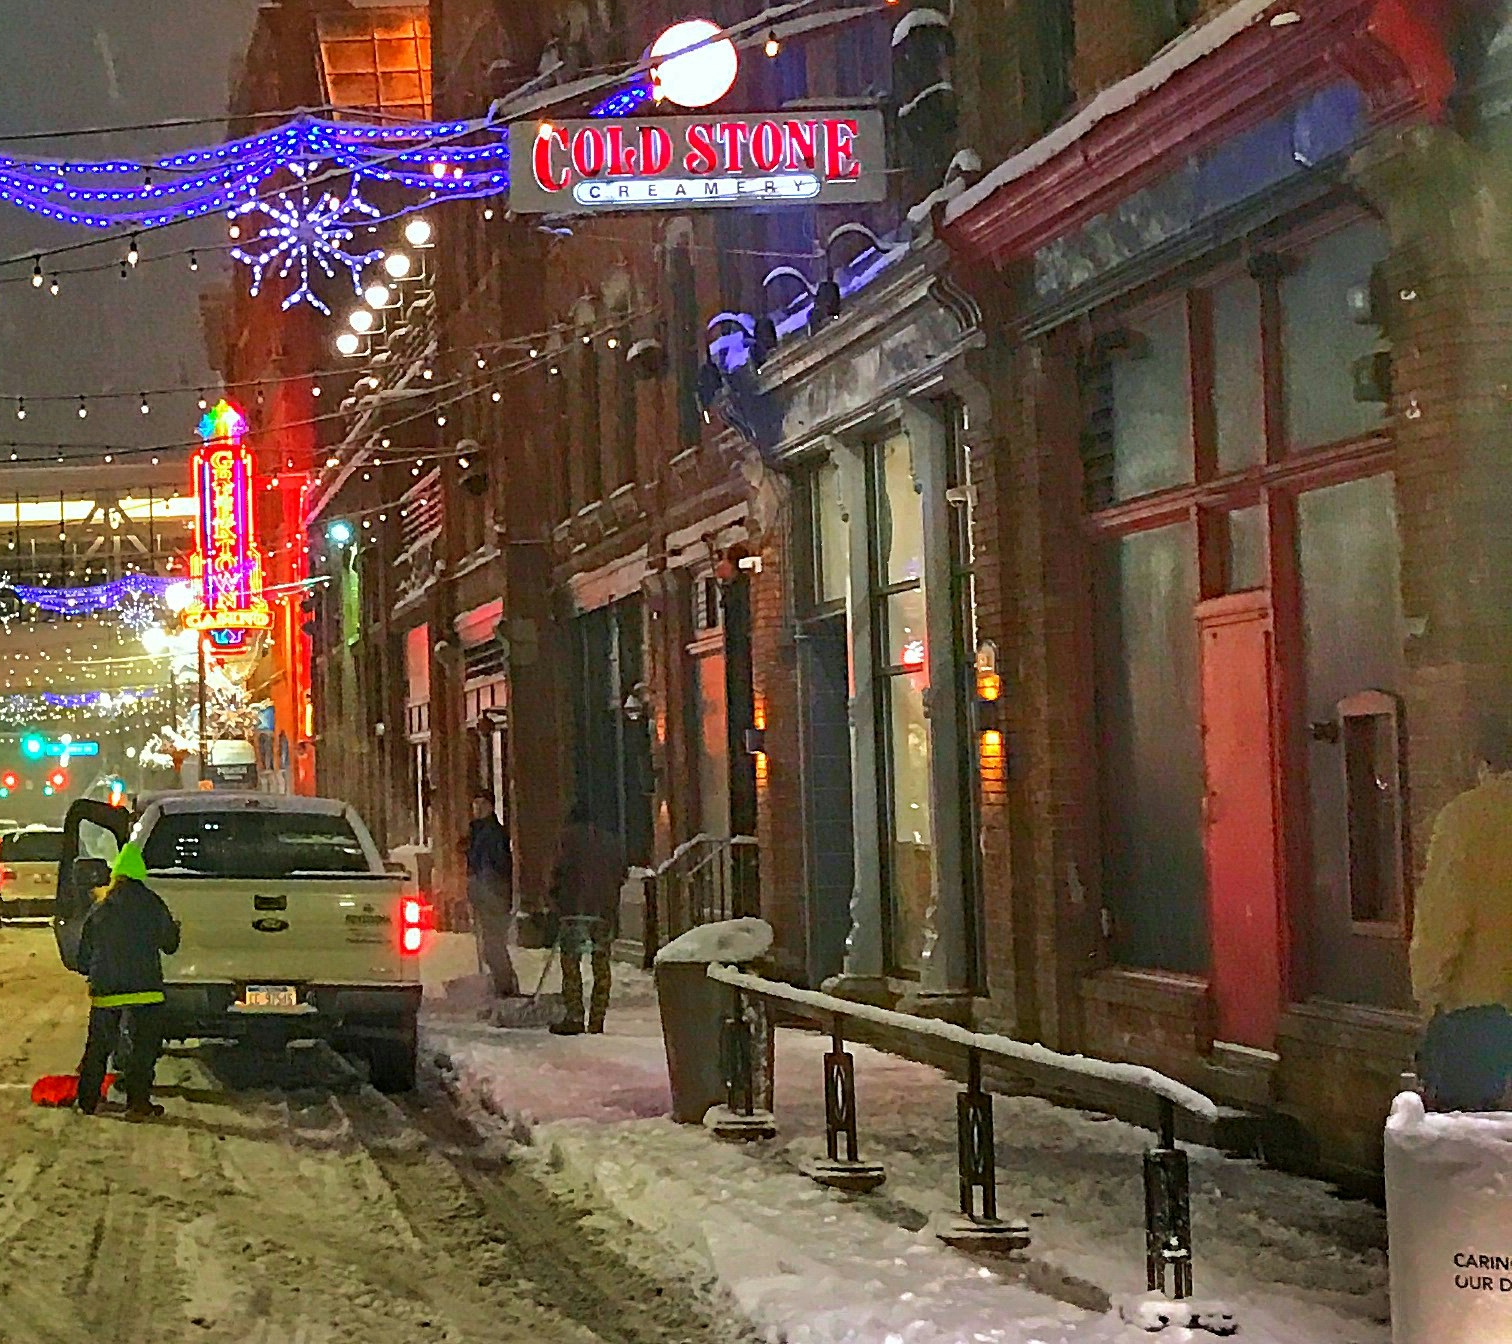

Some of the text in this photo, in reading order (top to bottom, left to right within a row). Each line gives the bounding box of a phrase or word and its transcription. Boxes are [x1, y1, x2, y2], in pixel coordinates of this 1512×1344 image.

[532, 118, 861, 194] COLD STONE
[588, 178, 806, 200] CREAMERY
[1453, 1252, 1512, 1270] CARIN
